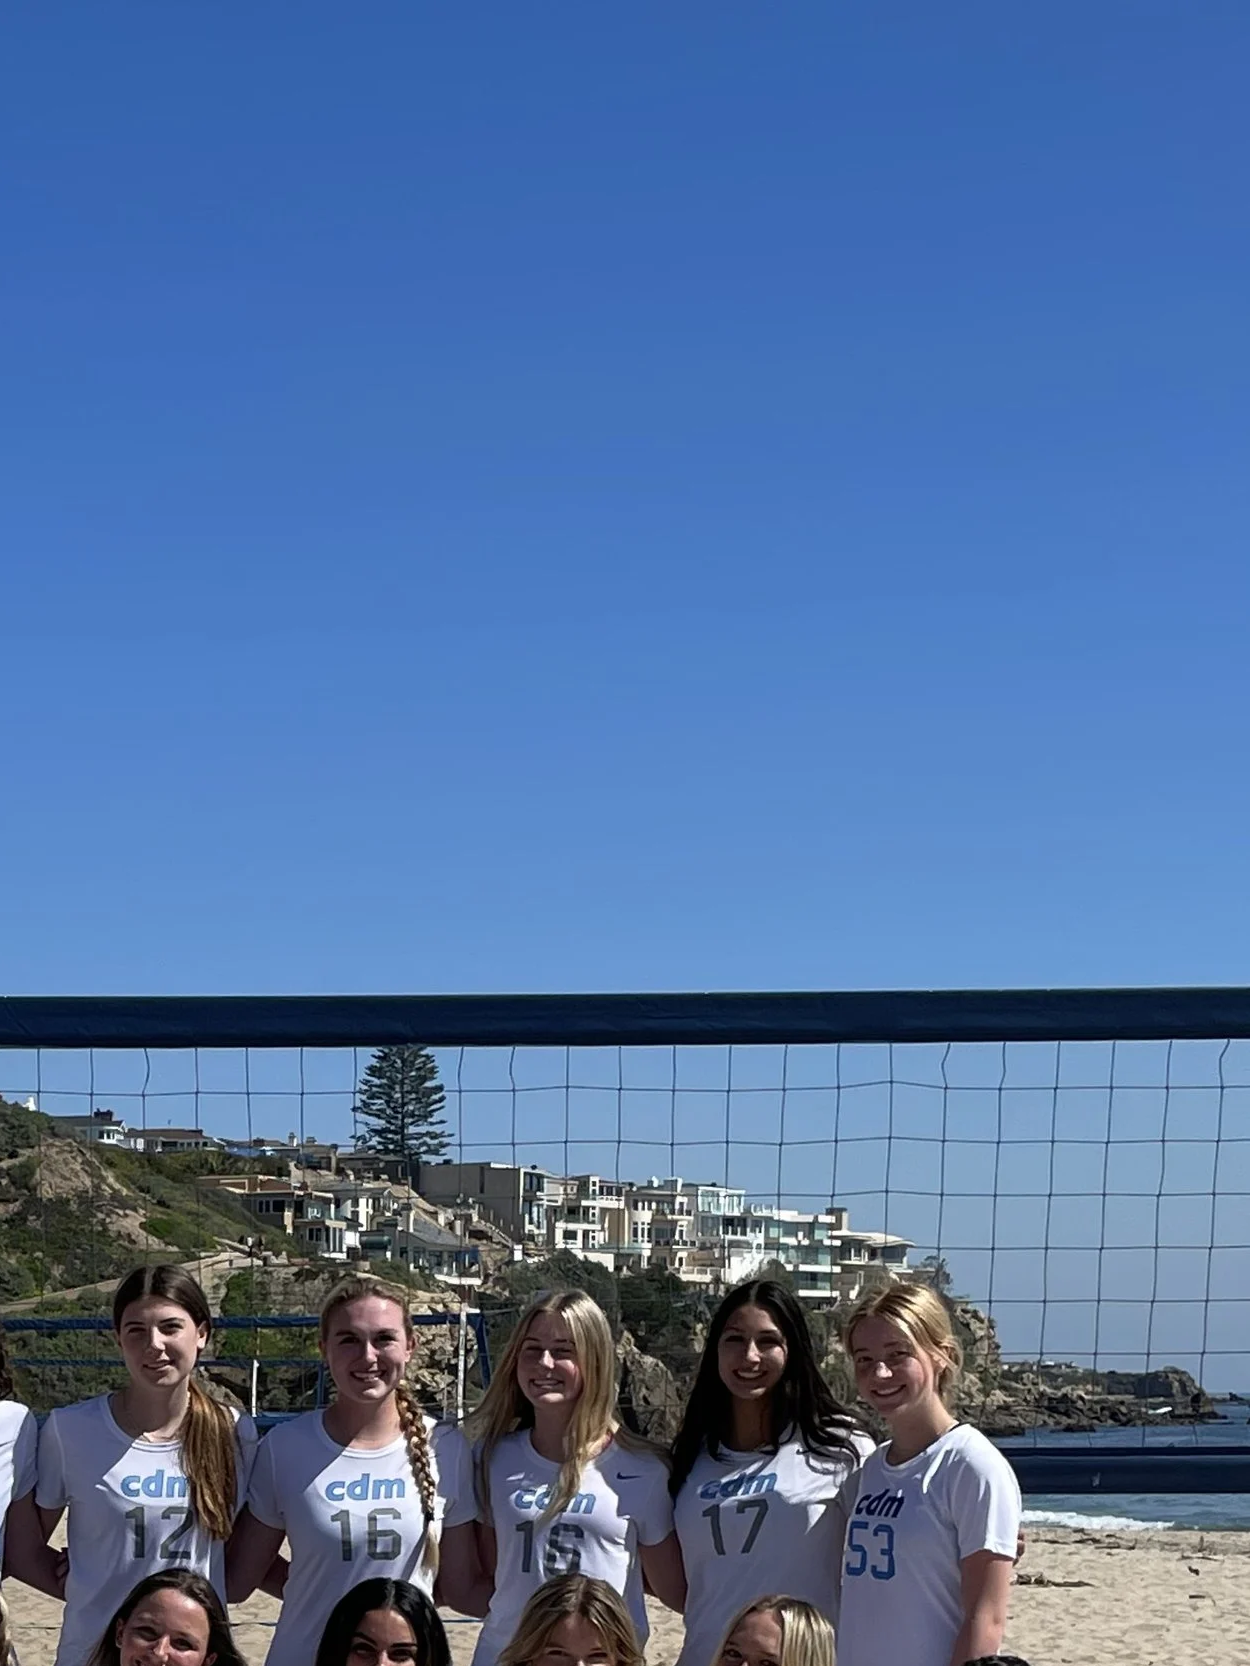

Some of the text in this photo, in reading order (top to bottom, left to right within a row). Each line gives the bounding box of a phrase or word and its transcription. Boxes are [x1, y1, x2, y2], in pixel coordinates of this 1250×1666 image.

[120, 1469, 189, 1498] cdm
[325, 1473, 405, 1502] cdm
[699, 1472, 777, 1500] cdm
[855, 1489, 905, 1518] cdm
[124, 1506, 193, 1560] 12
[330, 1507, 402, 1562] 16
[702, 1499, 769, 1556] 17
[846, 1521, 896, 1581] 53
